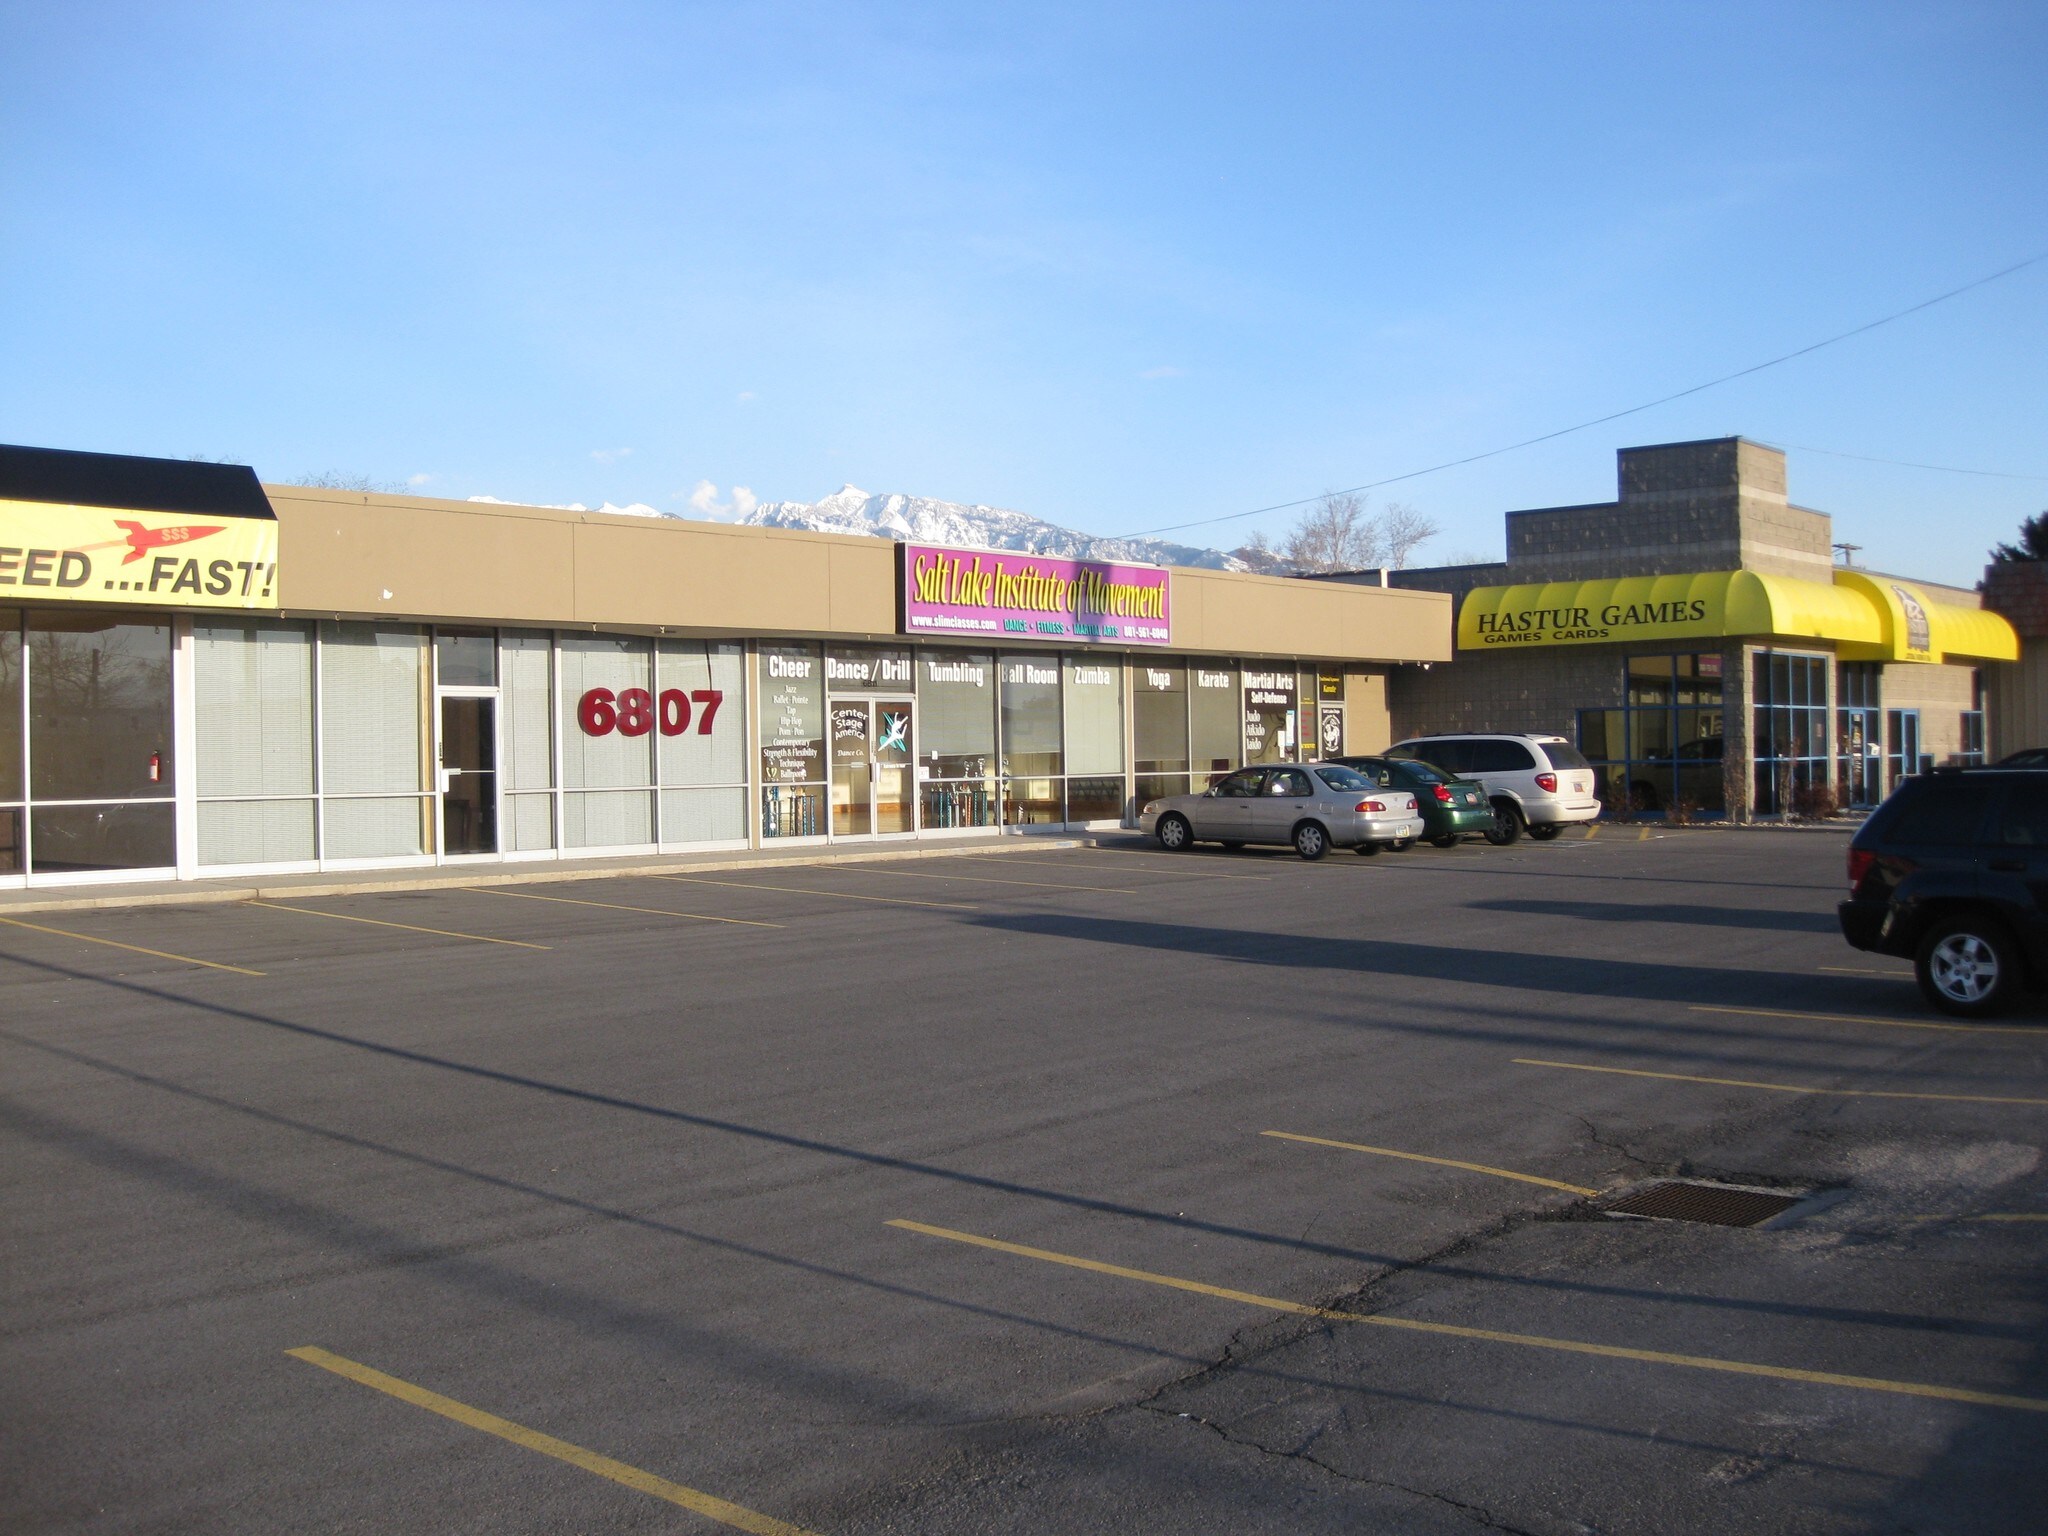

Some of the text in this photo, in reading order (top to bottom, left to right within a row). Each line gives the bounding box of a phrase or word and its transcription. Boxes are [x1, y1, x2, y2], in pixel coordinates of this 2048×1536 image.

[914, 553, 1166, 622] Salt Lake Institute of Movement
[911, 614, 997, 630] www.slimclasses.com
[1003, 619, 1028, 632] DANCE
[1036, 621, 1064, 634] FITNESS
[1103, 625, 1119, 638] ARTS
[1477, 600, 1706, 634] HASTUR GAMES
[1484, 628, 1609, 644] GAMES CARDS
[769, 655, 811, 678] Cheer
[828, 657, 869, 680] Dance
[882, 659, 911, 681] Drill
[928, 662, 984, 687] Tumbling
[1026, 665, 1058, 685] Room
[1074, 667, 1110, 685] Zumba
[1146, 668, 1171, 690] Yoga
[1198, 670, 1229, 688] Karate
[1244, 672, 1294, 690] Martial Arts
[1251, 691, 1288, 704] Self-Defense
[577, 687, 723, 737] 6807
[785, 705, 797, 717] Tap
[831, 709, 869, 720] Center
[1246, 710, 1261, 722] Judo
[835, 719, 864, 730] Stage
[1246, 723, 1266, 737] Aikido
[772, 738, 811, 748] Contemporary
[835, 729, 866, 741] America
[763, 748, 787, 760] Strength
[792, 748, 818, 759] Flexibility
[779, 759, 806, 769] Technique
